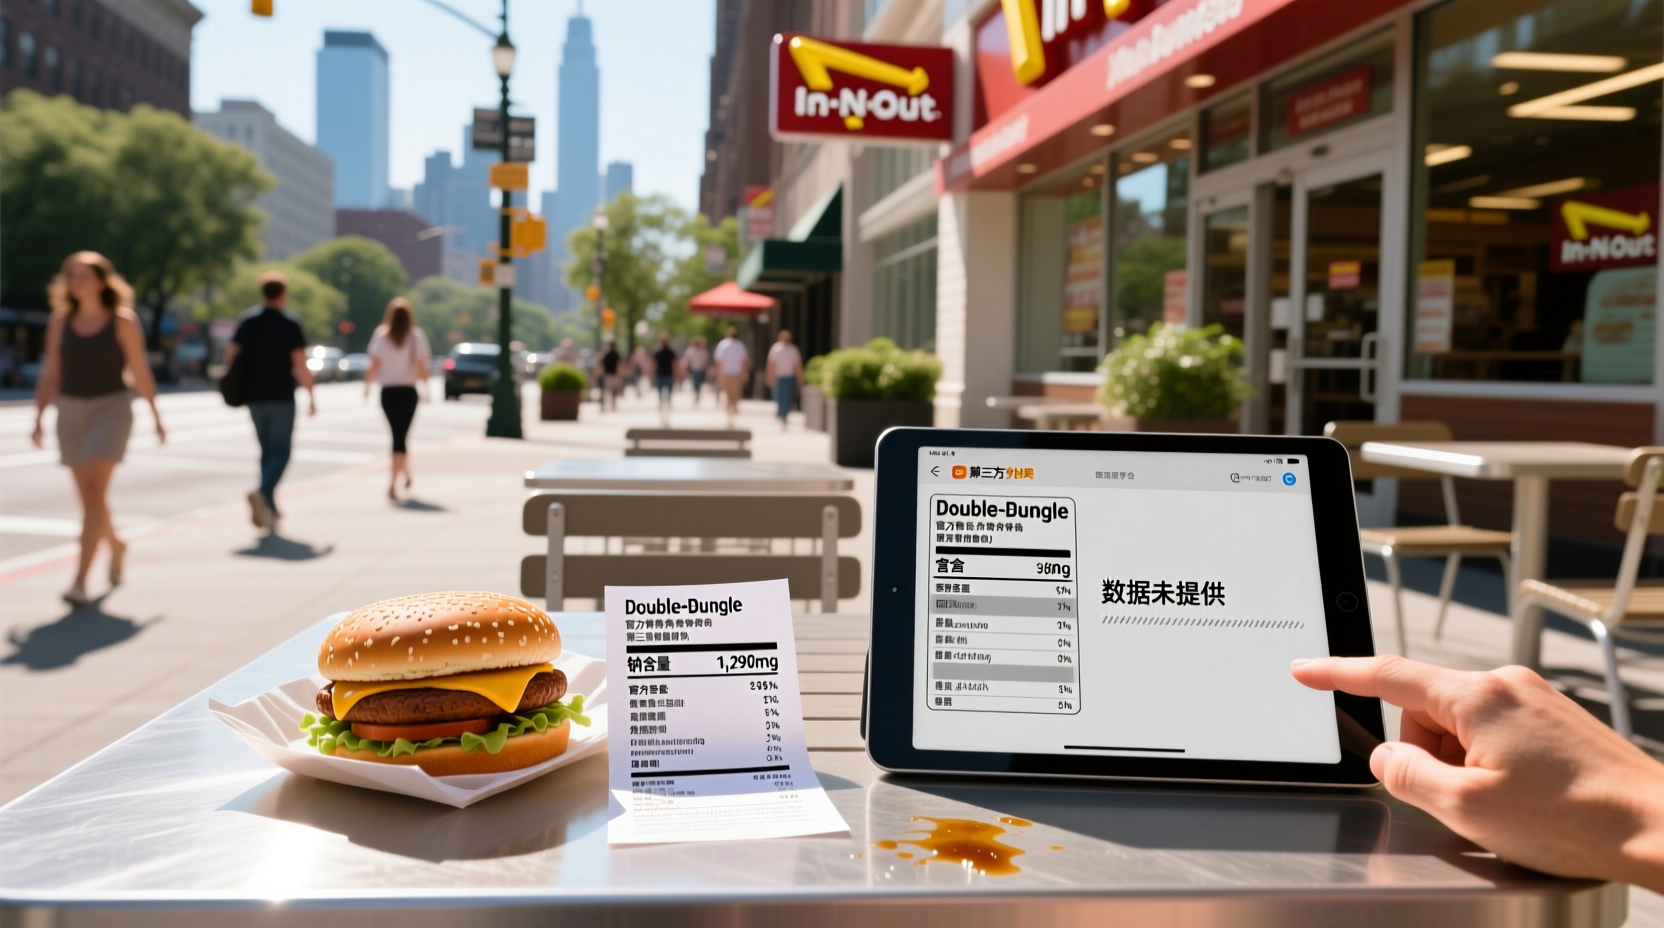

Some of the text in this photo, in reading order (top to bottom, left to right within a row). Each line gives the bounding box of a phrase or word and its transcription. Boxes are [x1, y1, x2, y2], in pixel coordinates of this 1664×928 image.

[1101, 577, 1226, 606] 数据未提供
[716, 654, 779, 673] 1,290mg
